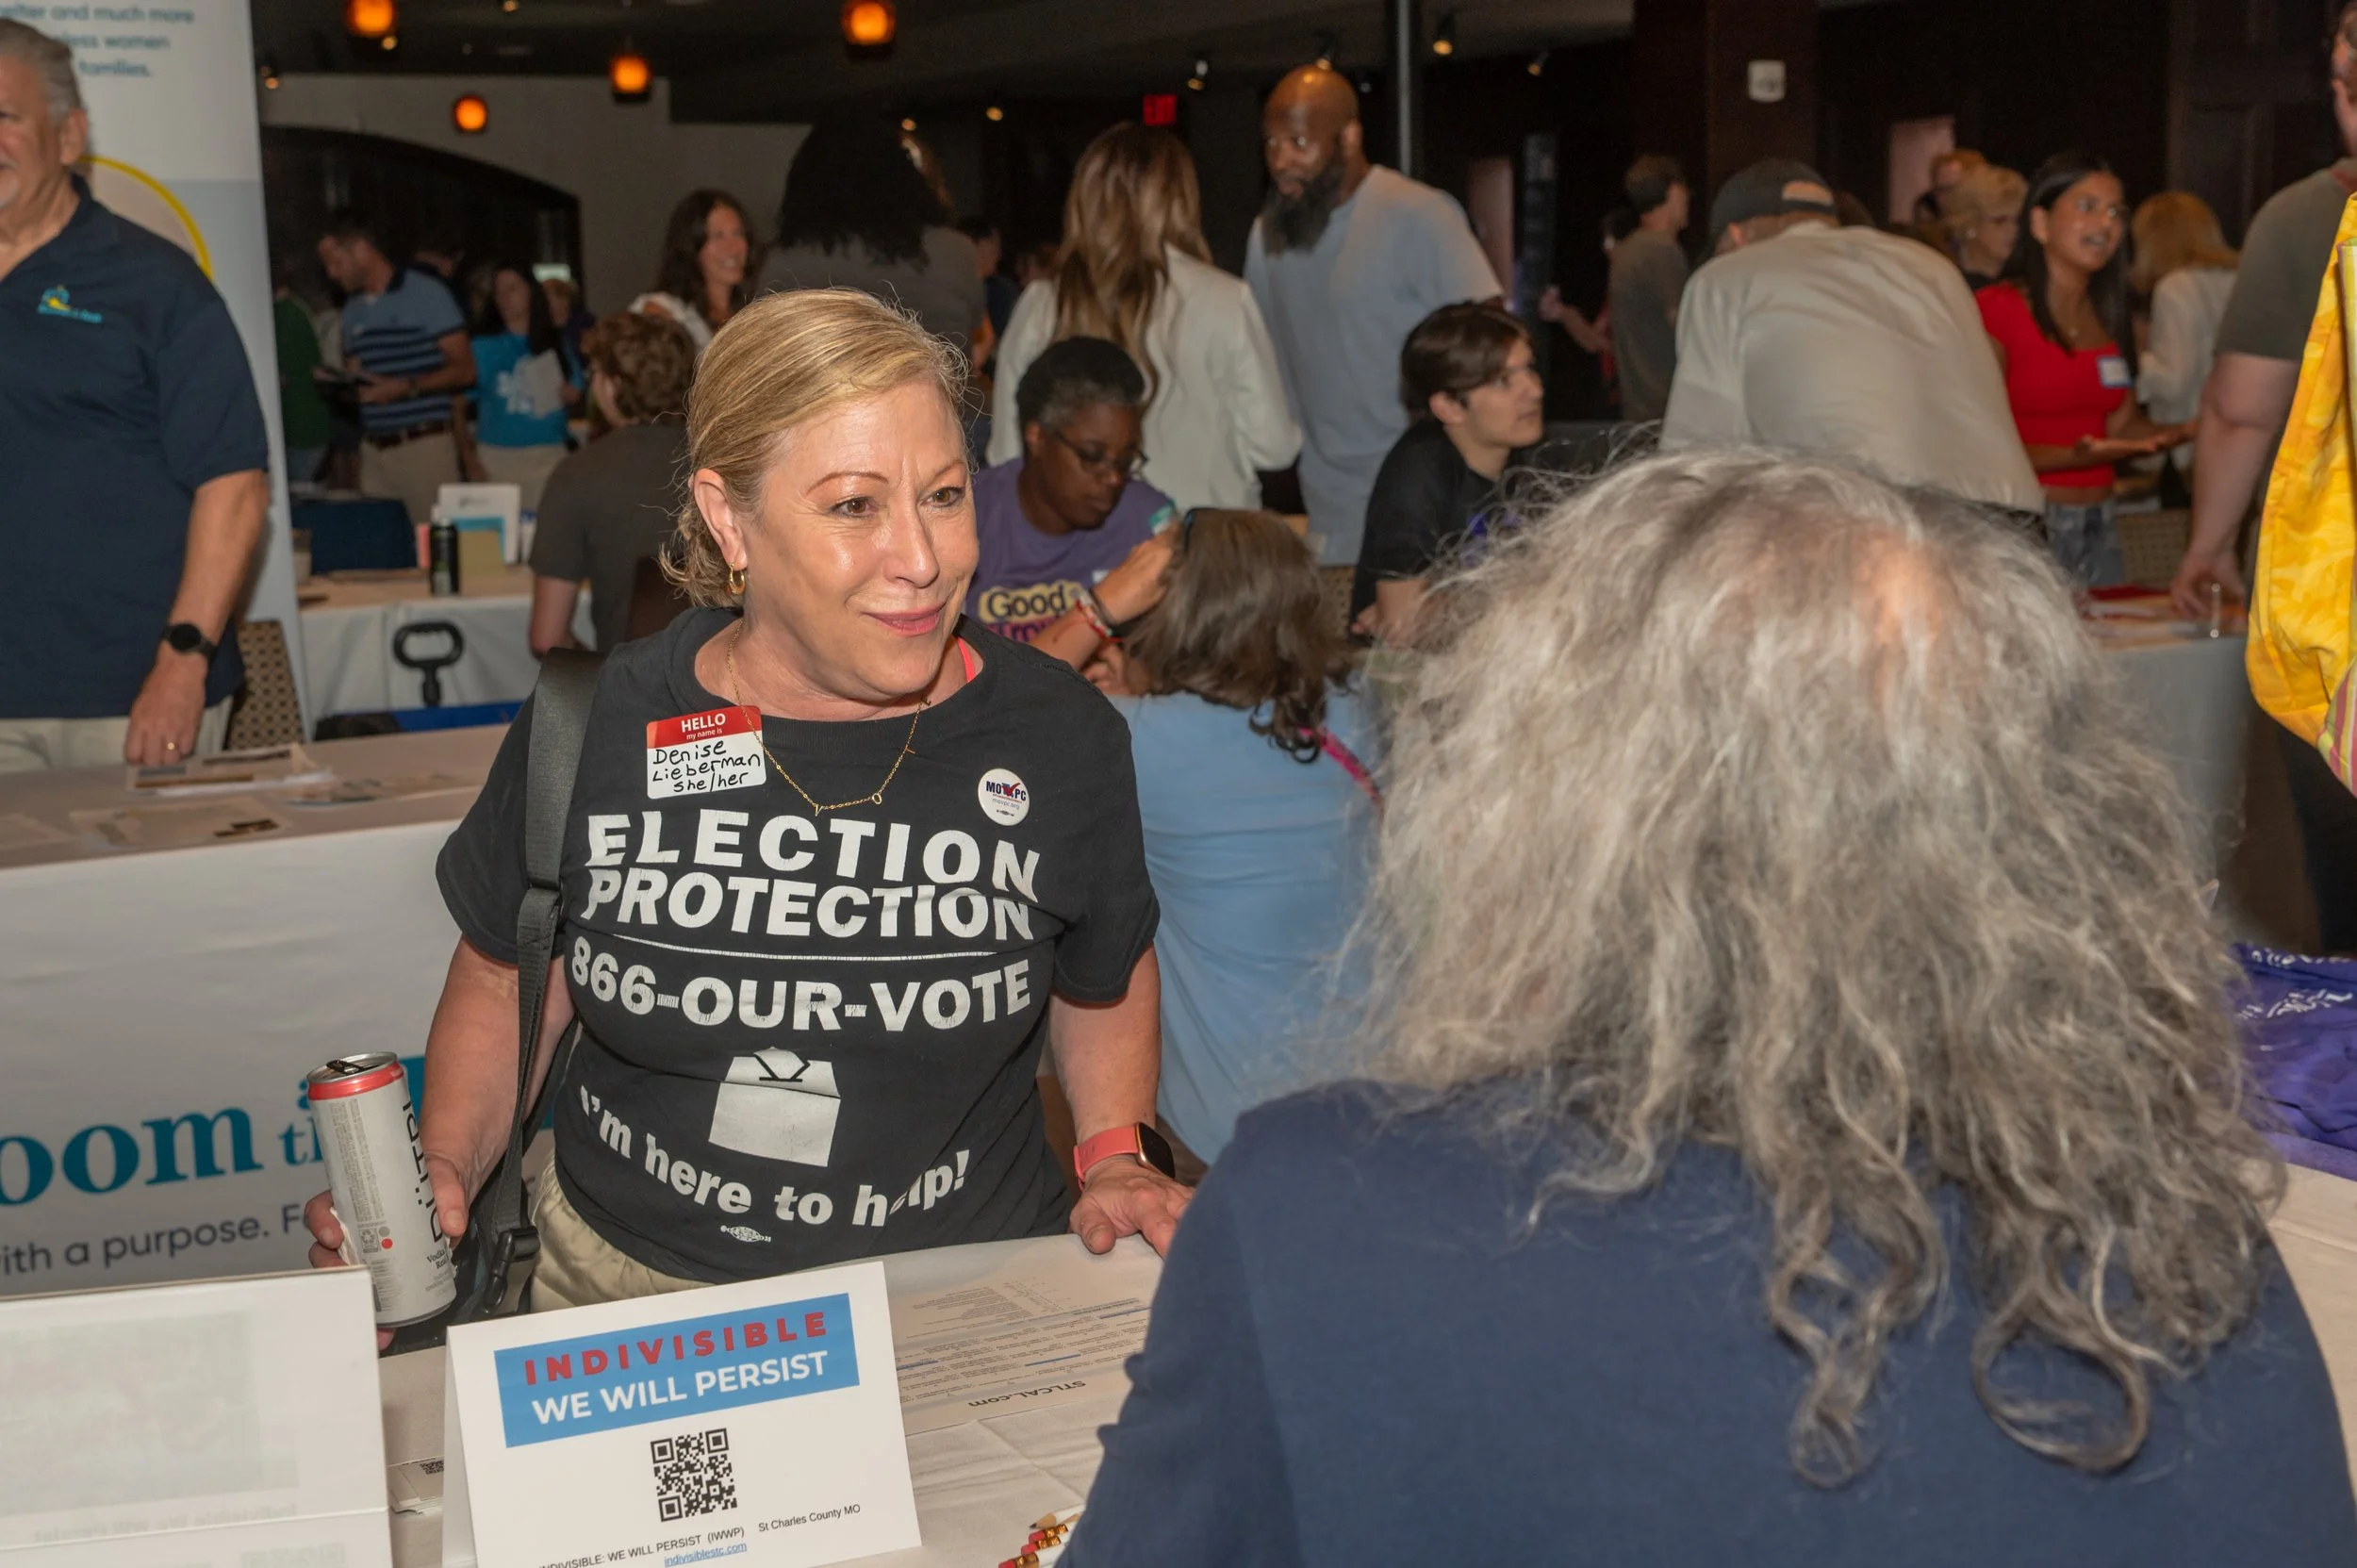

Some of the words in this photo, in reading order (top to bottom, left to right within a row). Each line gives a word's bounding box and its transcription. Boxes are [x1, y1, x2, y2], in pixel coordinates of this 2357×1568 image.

[50, 4, 90, 21] and
[987, 585, 1066, 619] Good
[652, 740, 727, 765] Denise
[681, 713, 727, 733] HELLO
[652, 753, 761, 782] Lieberman
[585, 809, 1041, 902] ELECTION
[580, 867, 1034, 940] PROTECTION
[571, 935, 1031, 1032] 866-OUR-VOTE
[644, 1132, 752, 1213] here
[773, 1185, 833, 1226] to
[0, 1241, 52, 1279] ith
[64, 1241, 91, 1266] a
[102, 1215, 270, 1269] purpose.
[524, 1311, 828, 1386] INDIVISIBLE
[532, 1391, 593, 1425] WE
[600, 1377, 687, 1413] WILL
[695, 1350, 829, 1397] PERSIST
[968, 1379, 1087, 1407] STLCAL.com
[607, 1549, 626, 1562] WE
[628, 1544, 654, 1560] WILL
[656, 1534, 702, 1552] PERSIST
[707, 1527, 745, 1544] (IWWP)
[758, 1522, 769, 1532] St
[770, 1515, 807, 1529] Charles
[809, 1508, 842, 1523] County
[844, 1503, 861, 1515] MO
[664, 1543, 748, 1568] indivisiblestc.com
